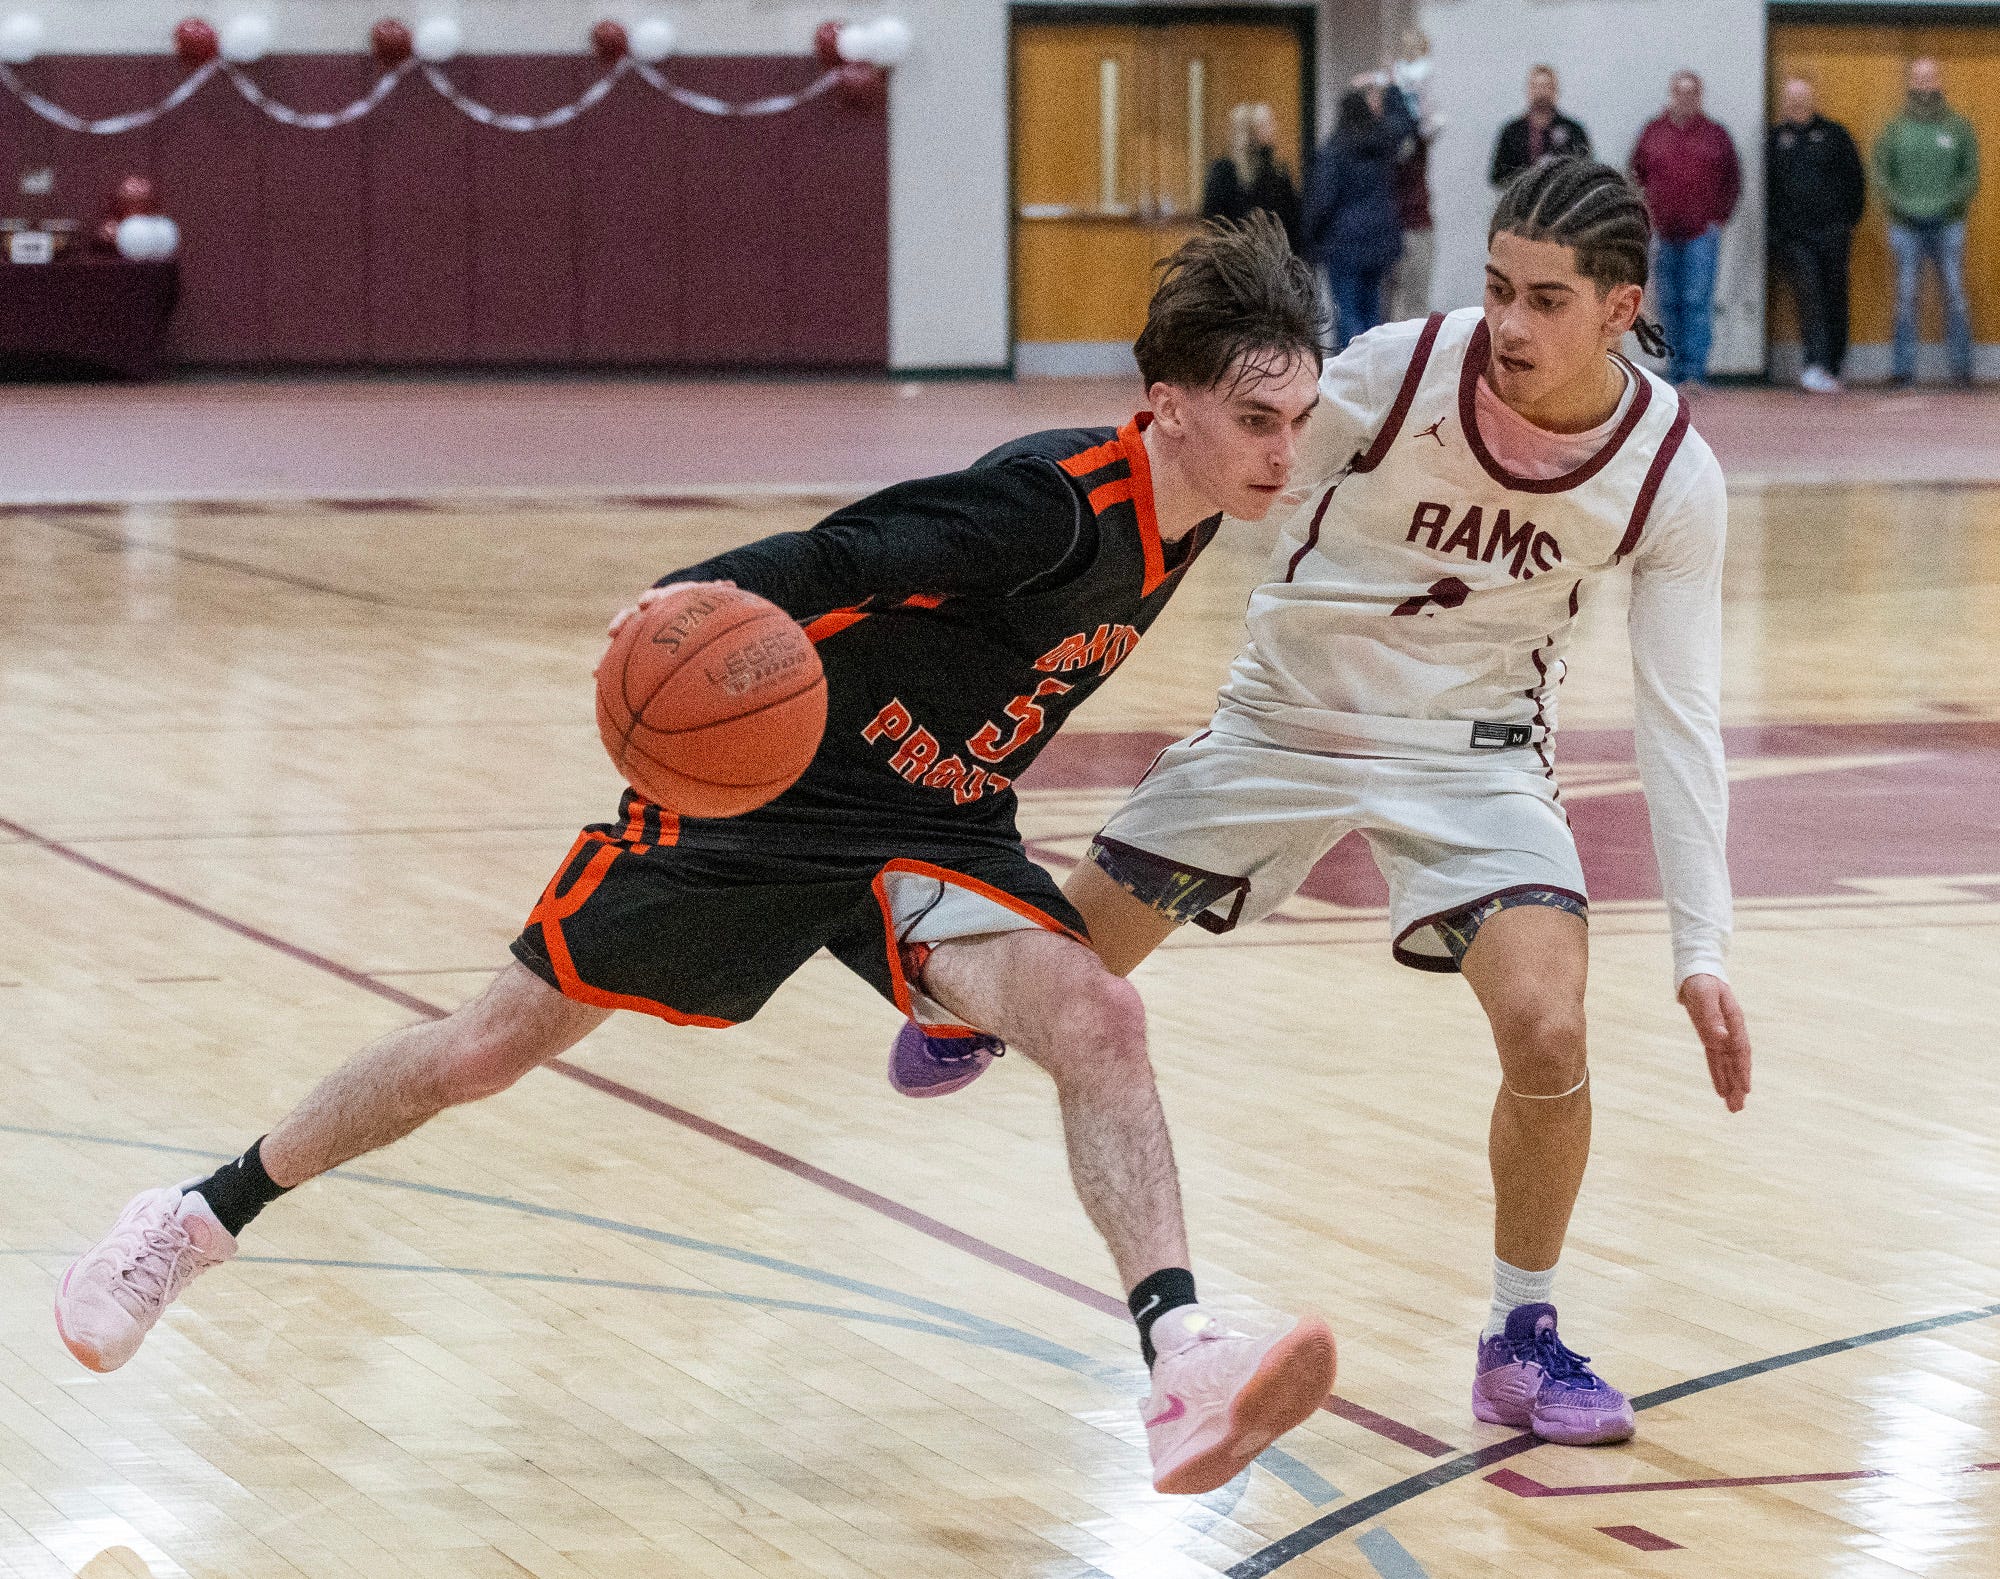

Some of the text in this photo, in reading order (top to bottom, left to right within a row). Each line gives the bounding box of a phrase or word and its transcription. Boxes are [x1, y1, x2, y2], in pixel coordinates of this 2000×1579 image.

[1406, 501, 1561, 580] RAMS
[966, 677, 1074, 763] 5
[1512, 733, 1523, 743] M
